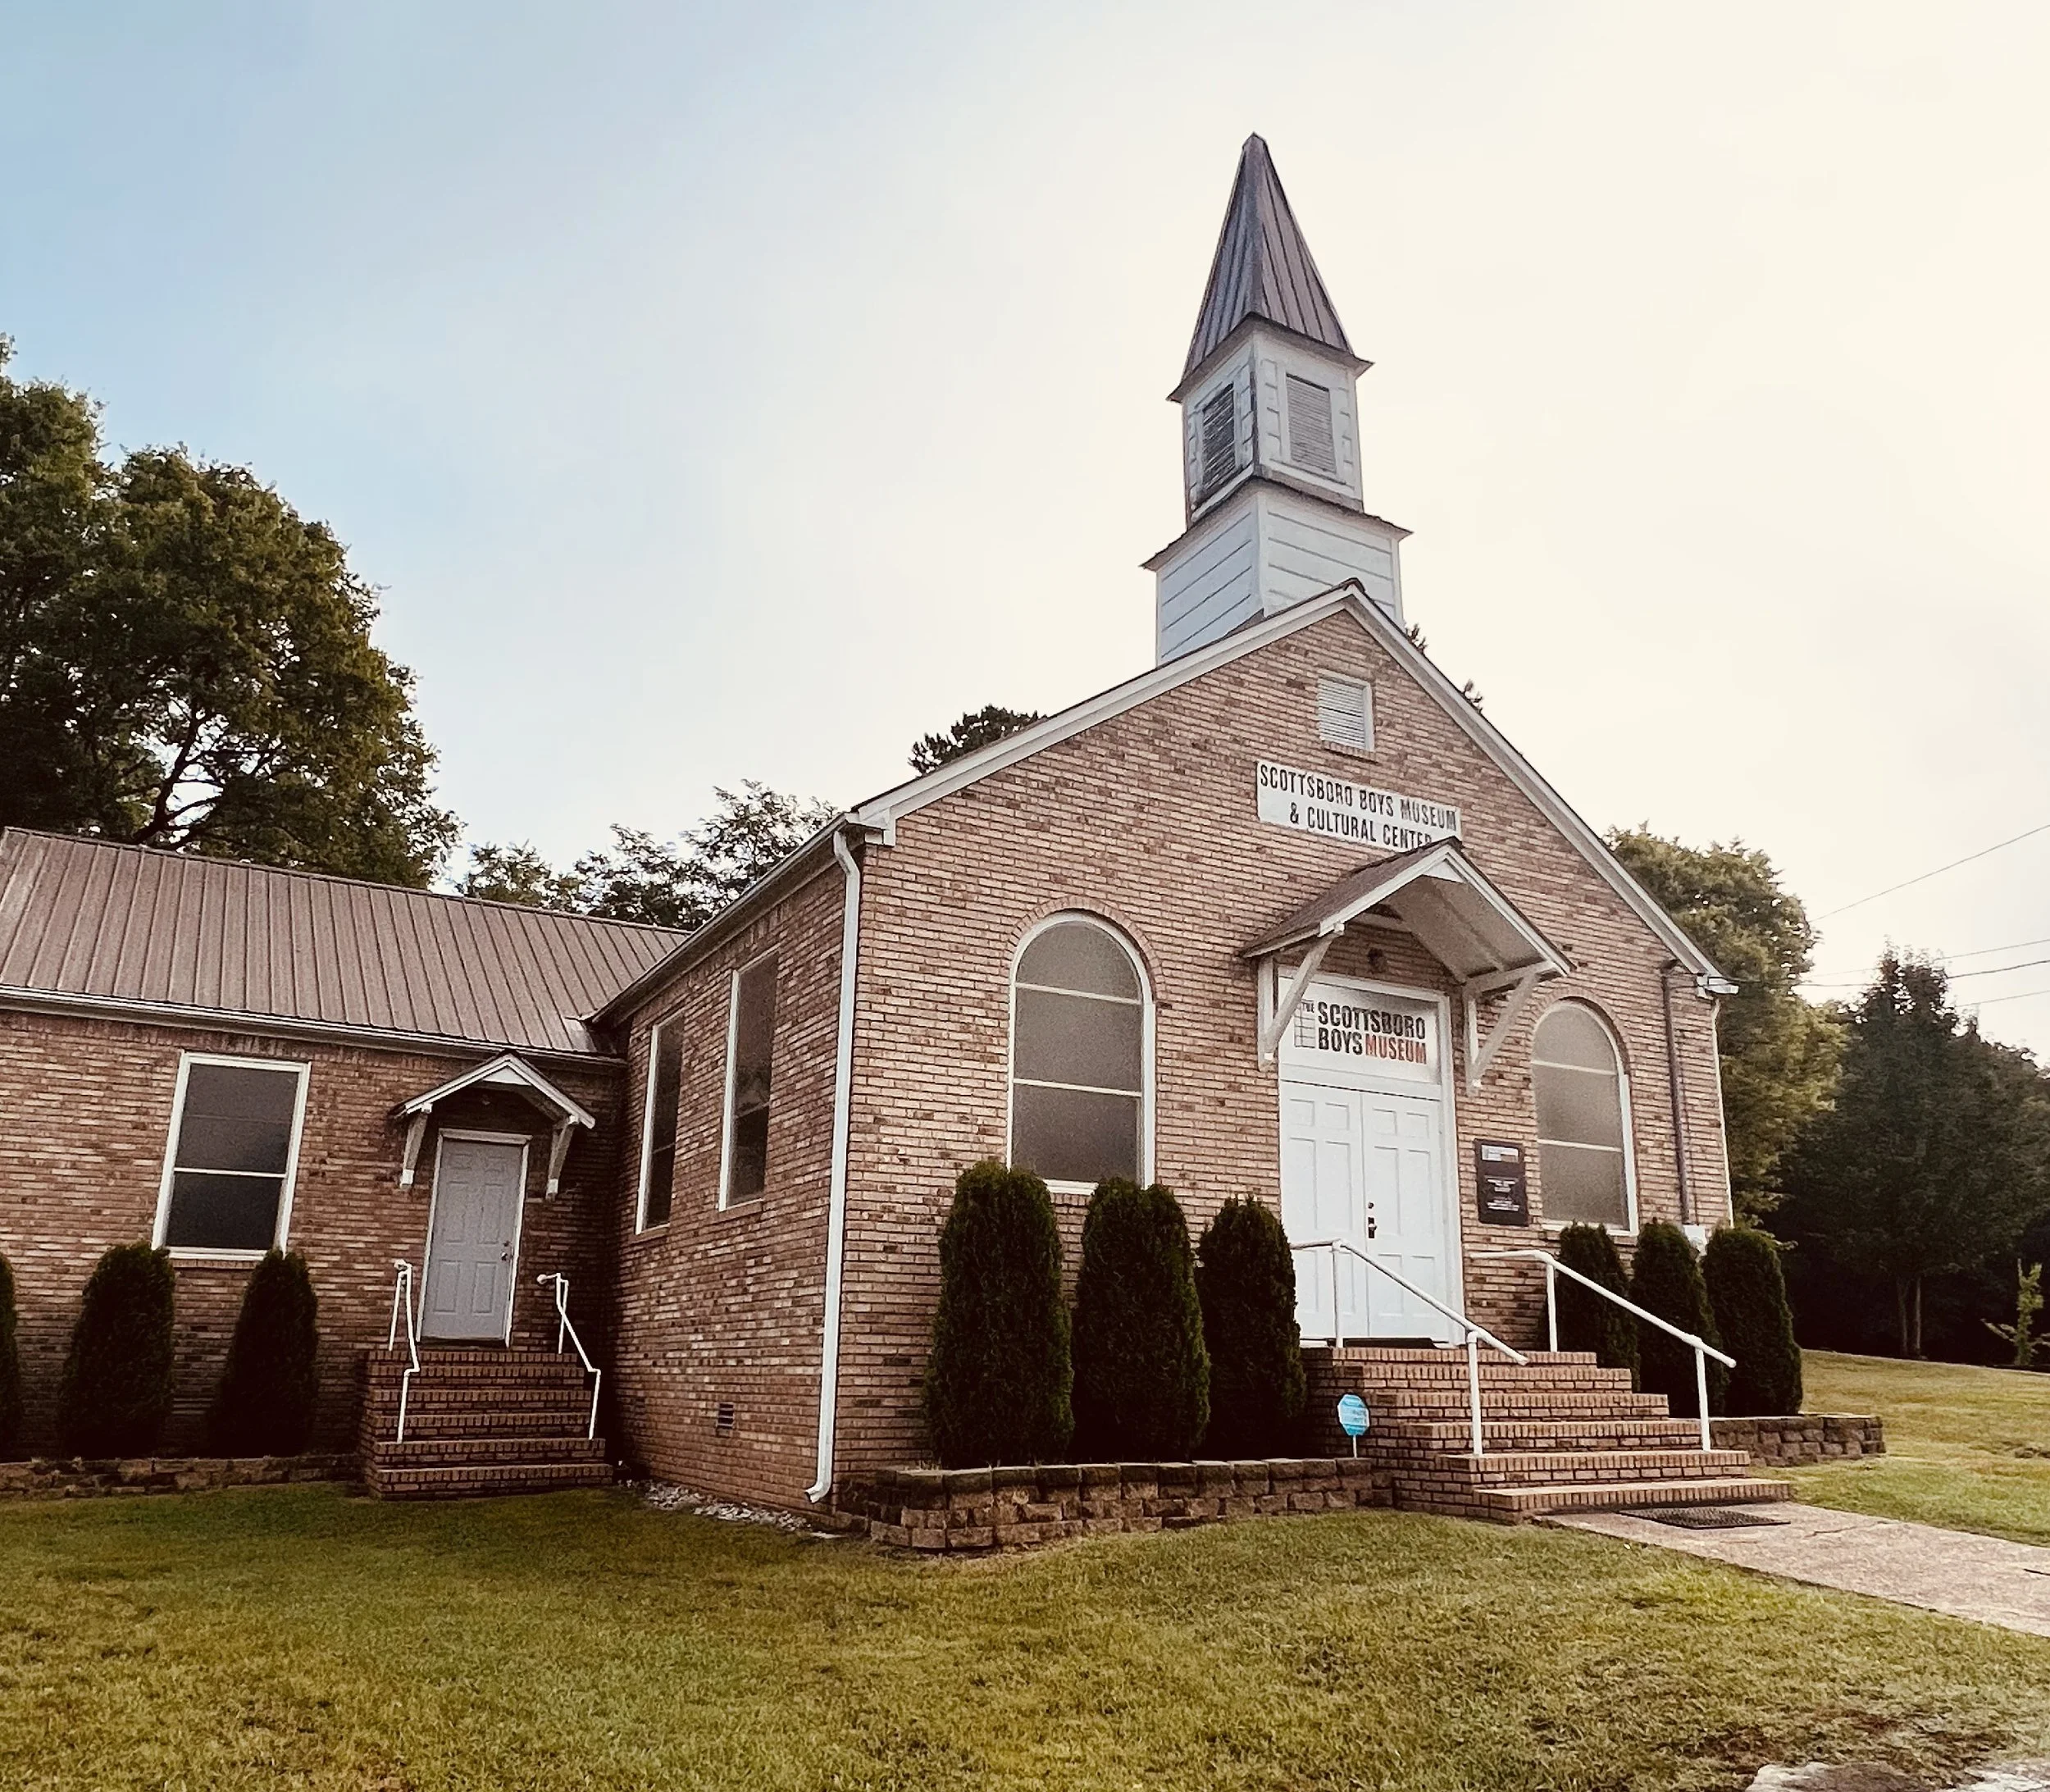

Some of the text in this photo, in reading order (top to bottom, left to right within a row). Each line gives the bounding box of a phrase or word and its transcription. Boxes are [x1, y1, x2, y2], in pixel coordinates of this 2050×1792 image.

[1260, 764, 1457, 832] SCOTTSBORO BOYS MUSEUM
[1289, 801, 1299, 824] &
[1307, 806, 1377, 842] CULTURAL
[1318, 1001, 1426, 1039] SCOTTSBORO
[1318, 1027, 1427, 1065] BOYS MUSEUM
